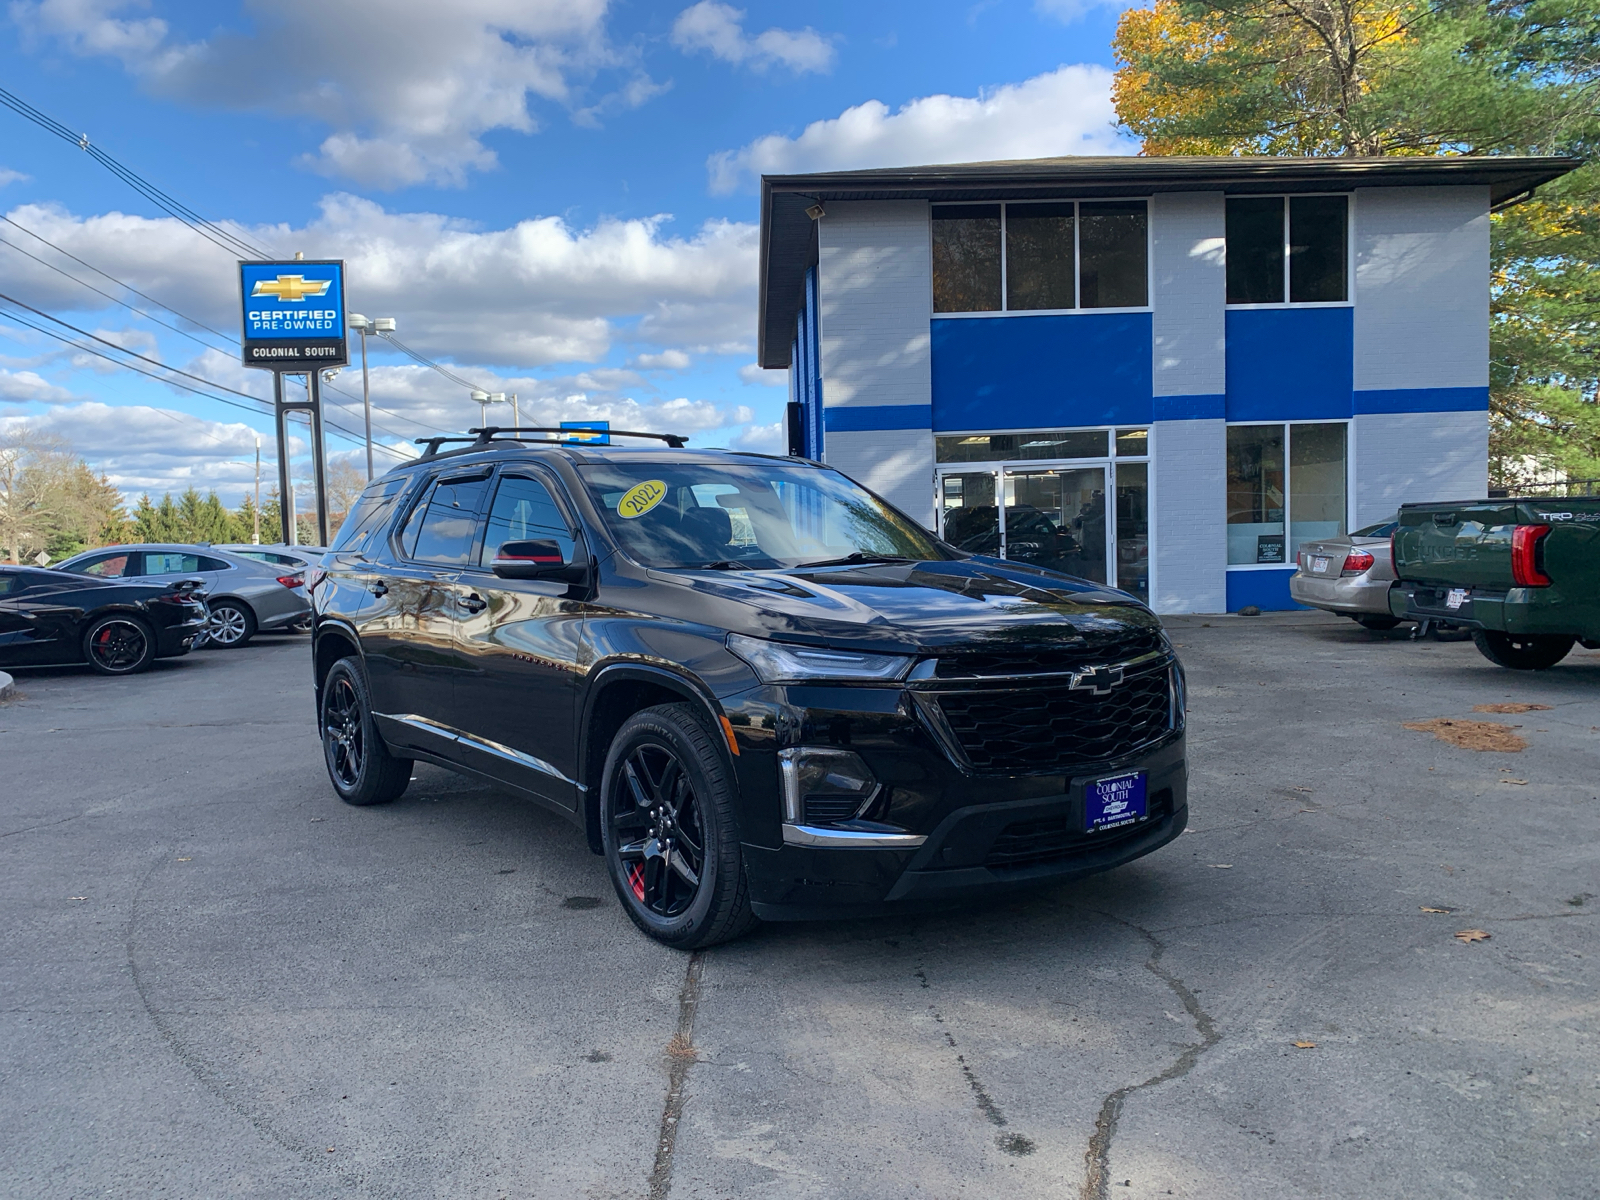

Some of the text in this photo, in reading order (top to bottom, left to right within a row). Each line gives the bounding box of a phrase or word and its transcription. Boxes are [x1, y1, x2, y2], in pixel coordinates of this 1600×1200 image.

[248, 310, 336, 320] CERTIFIED
[253, 320, 332, 330] PRE-OWNED
[253, 347, 336, 357] COLONIAL SOUTH
[626, 484, 661, 513] 2022
[1538, 512, 1573, 521] TRD
[1097, 780, 1134, 795] COLONIAL
[1102, 790, 1128, 803] SOUTH
